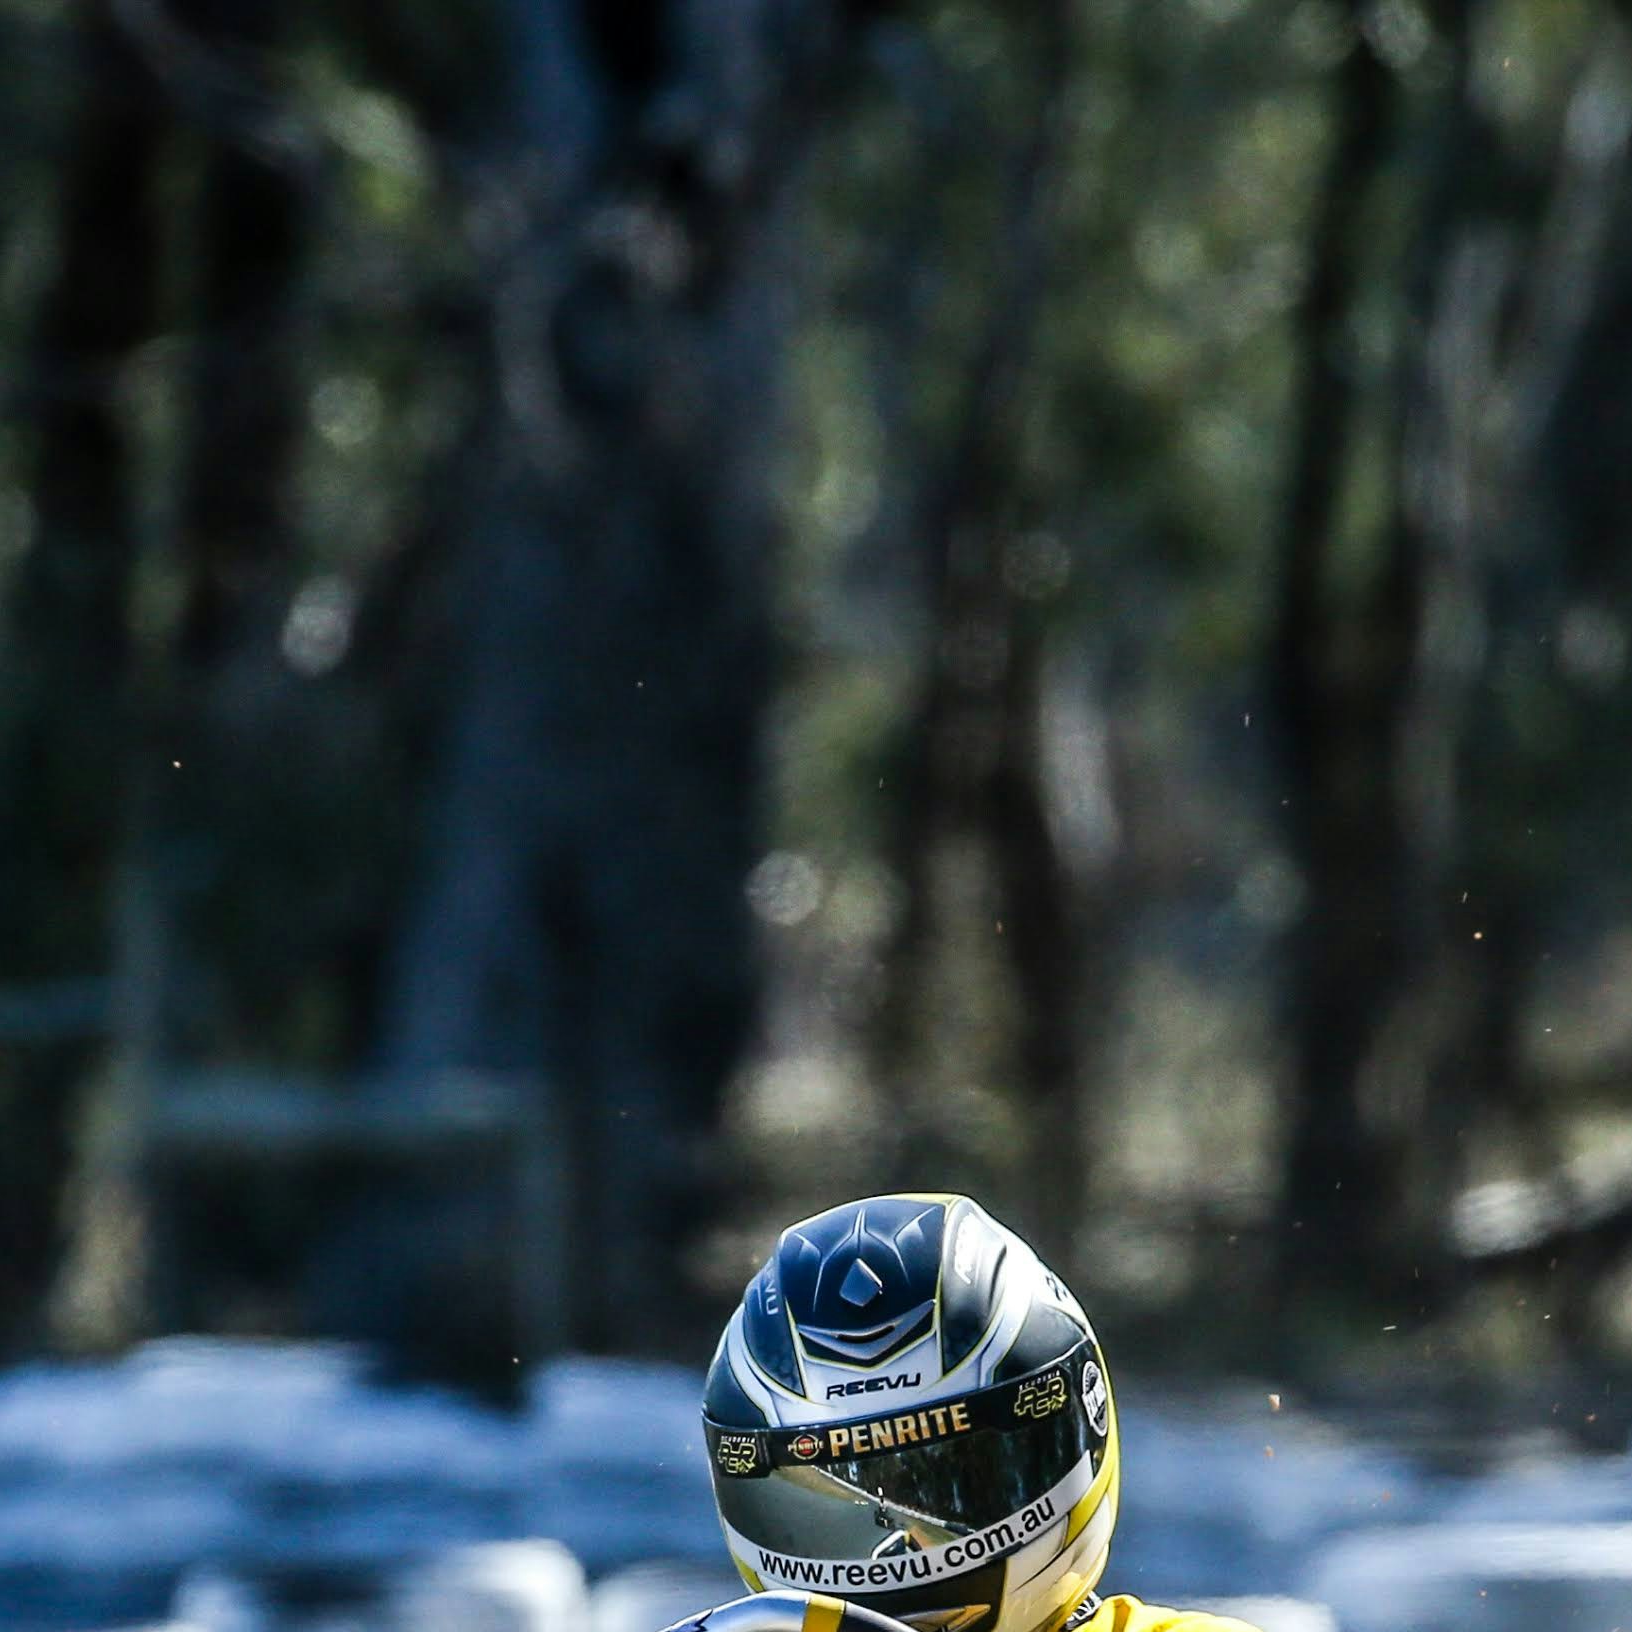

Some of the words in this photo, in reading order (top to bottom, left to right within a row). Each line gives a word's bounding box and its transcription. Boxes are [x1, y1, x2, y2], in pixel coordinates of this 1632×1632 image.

[826, 1373, 921, 1399] REEVU
[828, 1402, 971, 1457] PENRITE
[759, 1497, 1056, 1586] www.reevu.com.au
